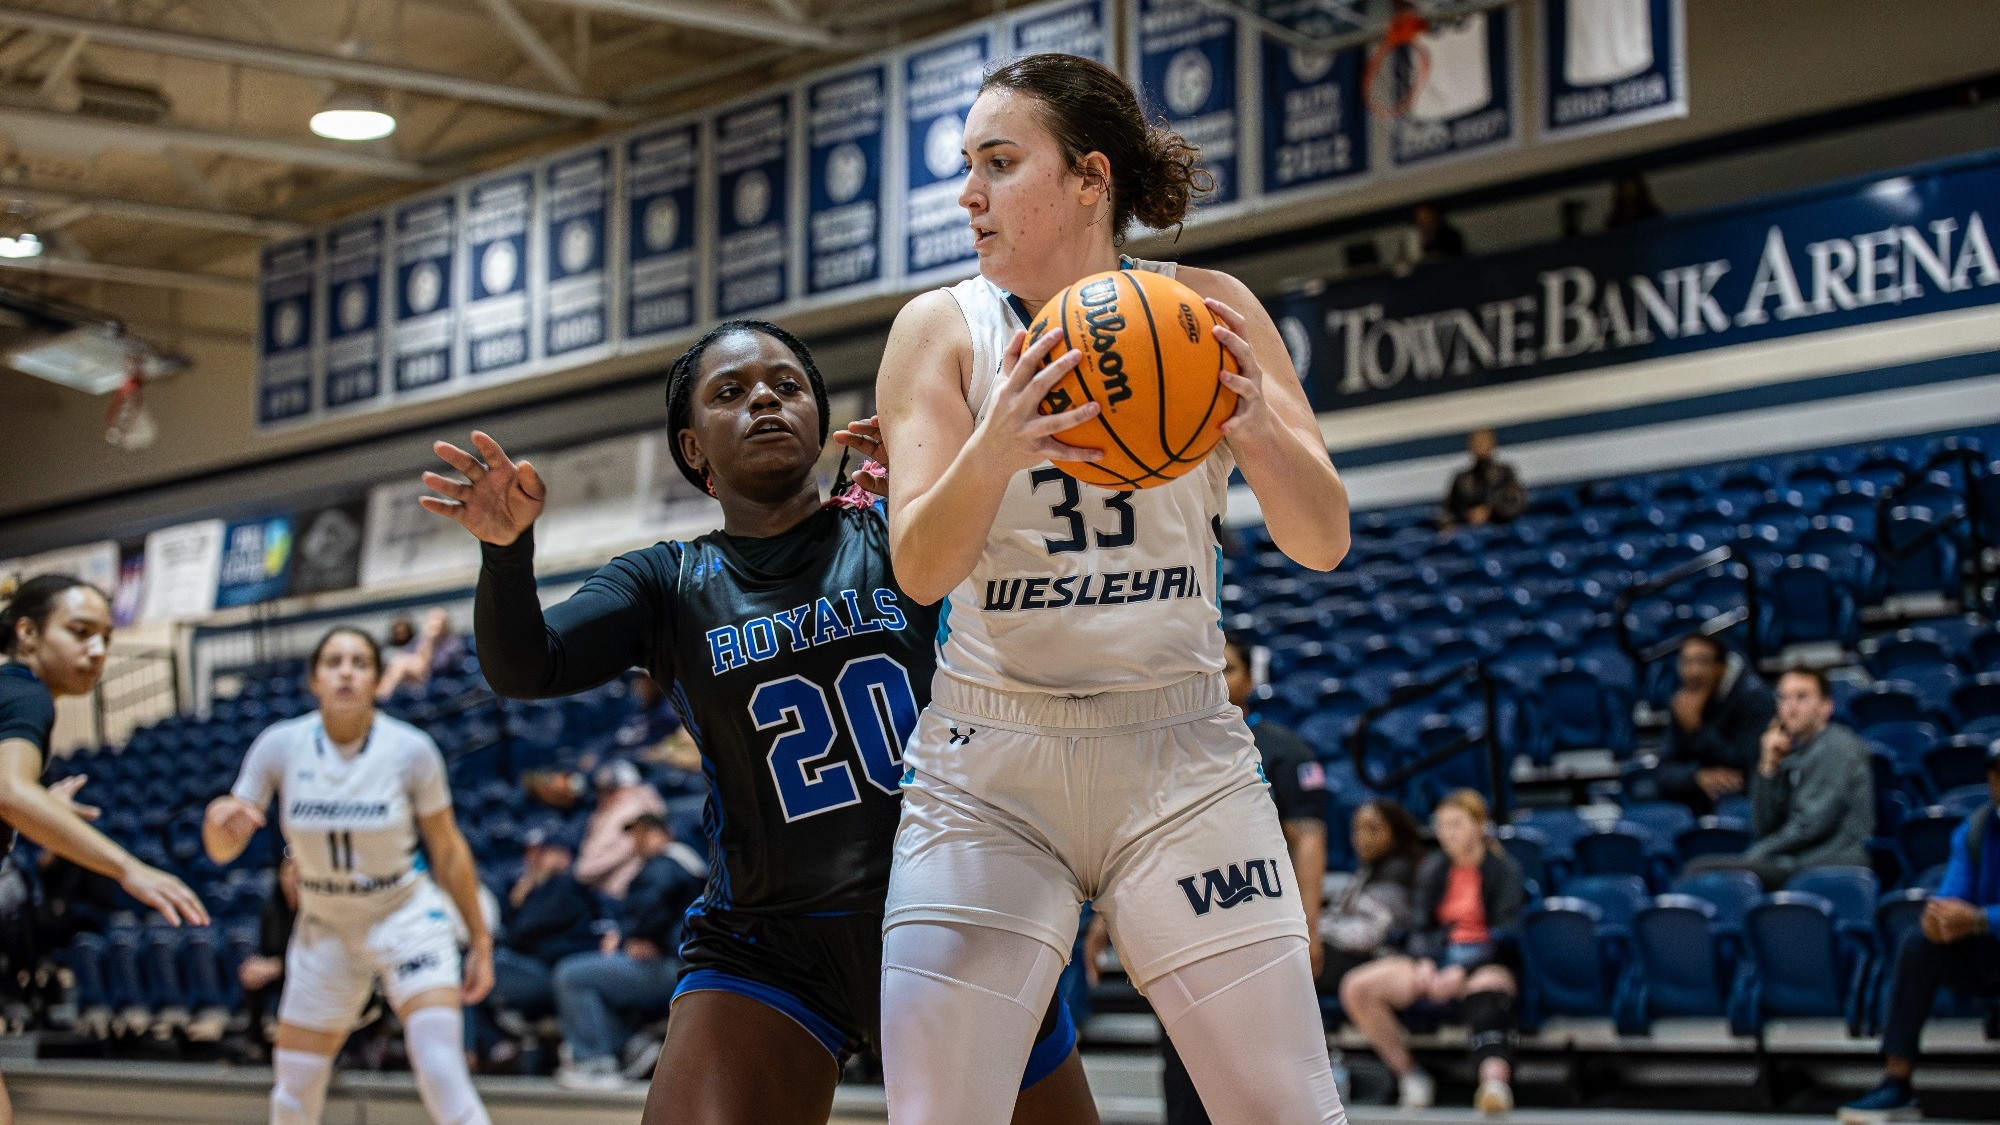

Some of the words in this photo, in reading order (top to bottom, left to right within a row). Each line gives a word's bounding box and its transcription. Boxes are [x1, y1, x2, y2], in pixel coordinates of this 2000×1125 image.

[1734, 210, 2000, 328] ARENA
[1080, 277, 1132, 406] Wilson
[1180, 303, 1199, 344] ODAC
[1028, 465, 1137, 557] 33
[706, 588, 907, 676] ROYALS
[747, 652, 919, 824] 20
[327, 830, 353, 871] 11
[1176, 857, 1283, 918] VWU
